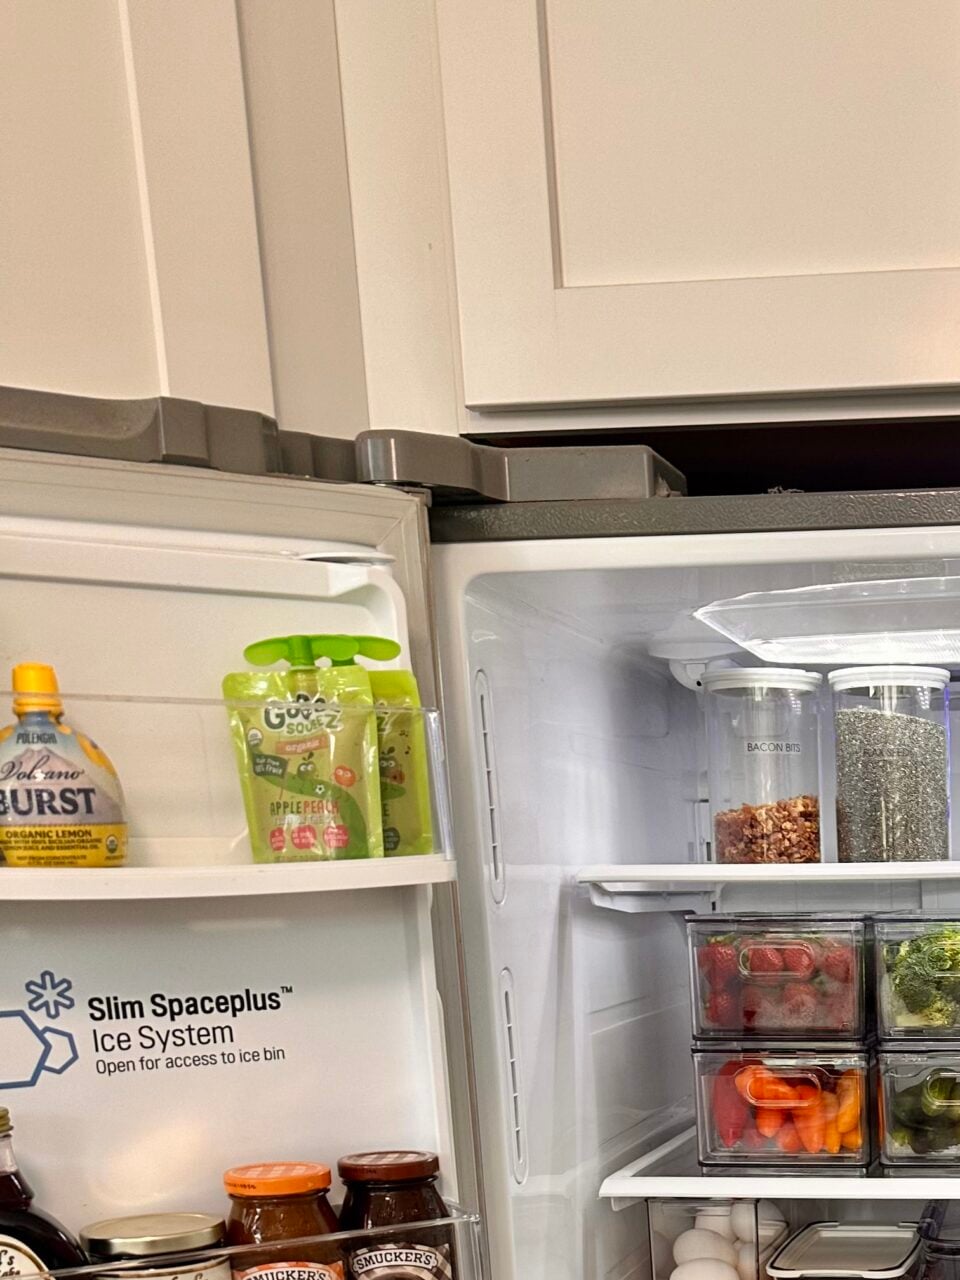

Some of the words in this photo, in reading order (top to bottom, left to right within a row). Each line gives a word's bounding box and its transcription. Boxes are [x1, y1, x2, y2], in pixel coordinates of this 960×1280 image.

[747, 743, 783, 752] BACON
[785, 743, 800, 752] BITS
[270, 801, 301, 815] APPLE
[5, 831, 53, 839] ORGANIC
[55, 830, 92, 838] LEMON
[88, 996, 145, 1021] Slim
[93, 1028, 131, 1052] Ice
[139, 1025, 234, 1053] System
[96, 1058, 136, 1076] Open
[139, 1056, 161, 1071] for
[165, 1053, 218, 1068] access
[221, 1051, 236, 1064] to
[239, 1049, 260, 1063] ice
[263, 1046, 286, 1061] bin
[356, 1252, 435, 1271] SMUCKER'S
